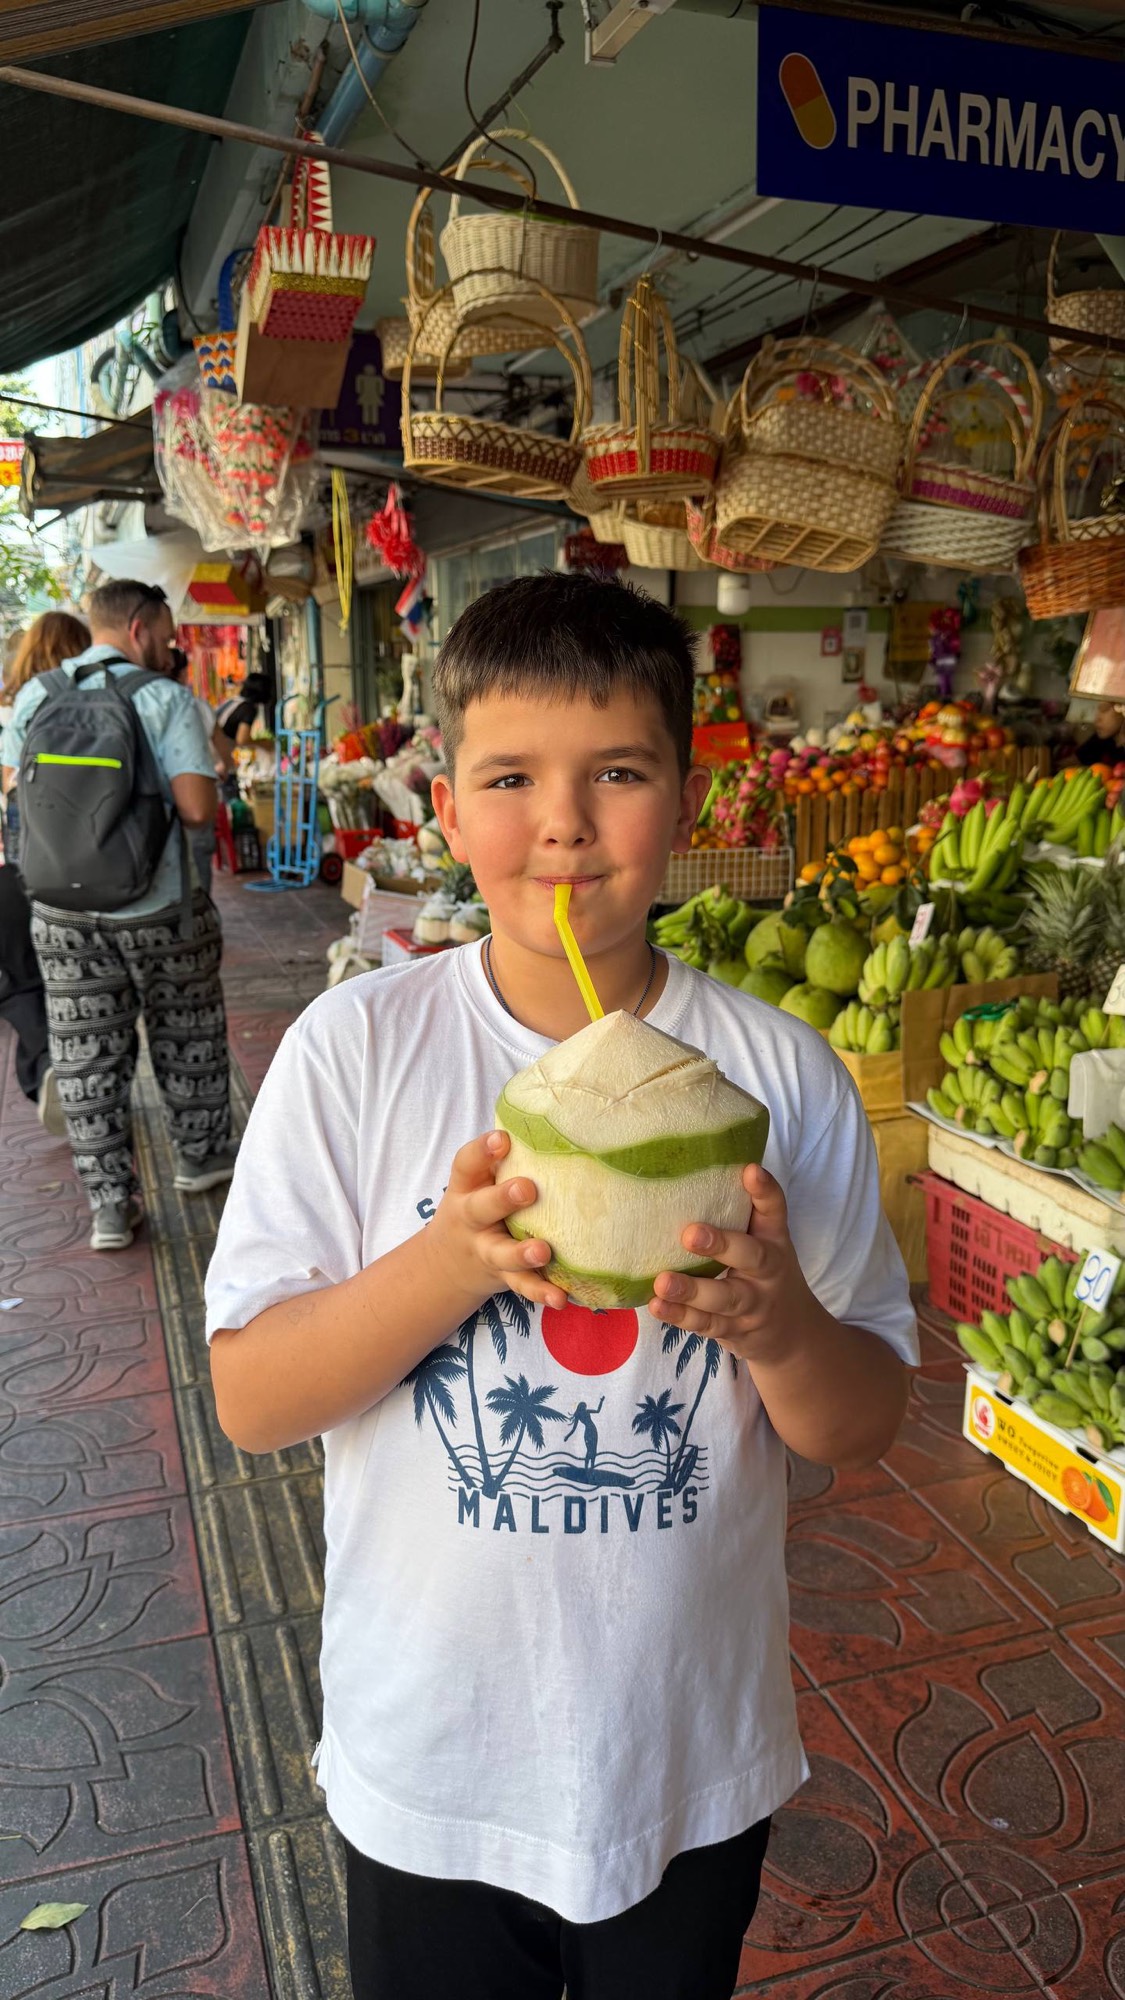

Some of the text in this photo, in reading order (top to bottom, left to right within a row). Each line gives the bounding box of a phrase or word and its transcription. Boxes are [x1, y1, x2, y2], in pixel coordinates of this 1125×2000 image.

[847, 75, 1125, 182] PHARMACY
[1076, 1255, 1111, 1303] 30
[458, 1486, 698, 1534] MALDIVES
